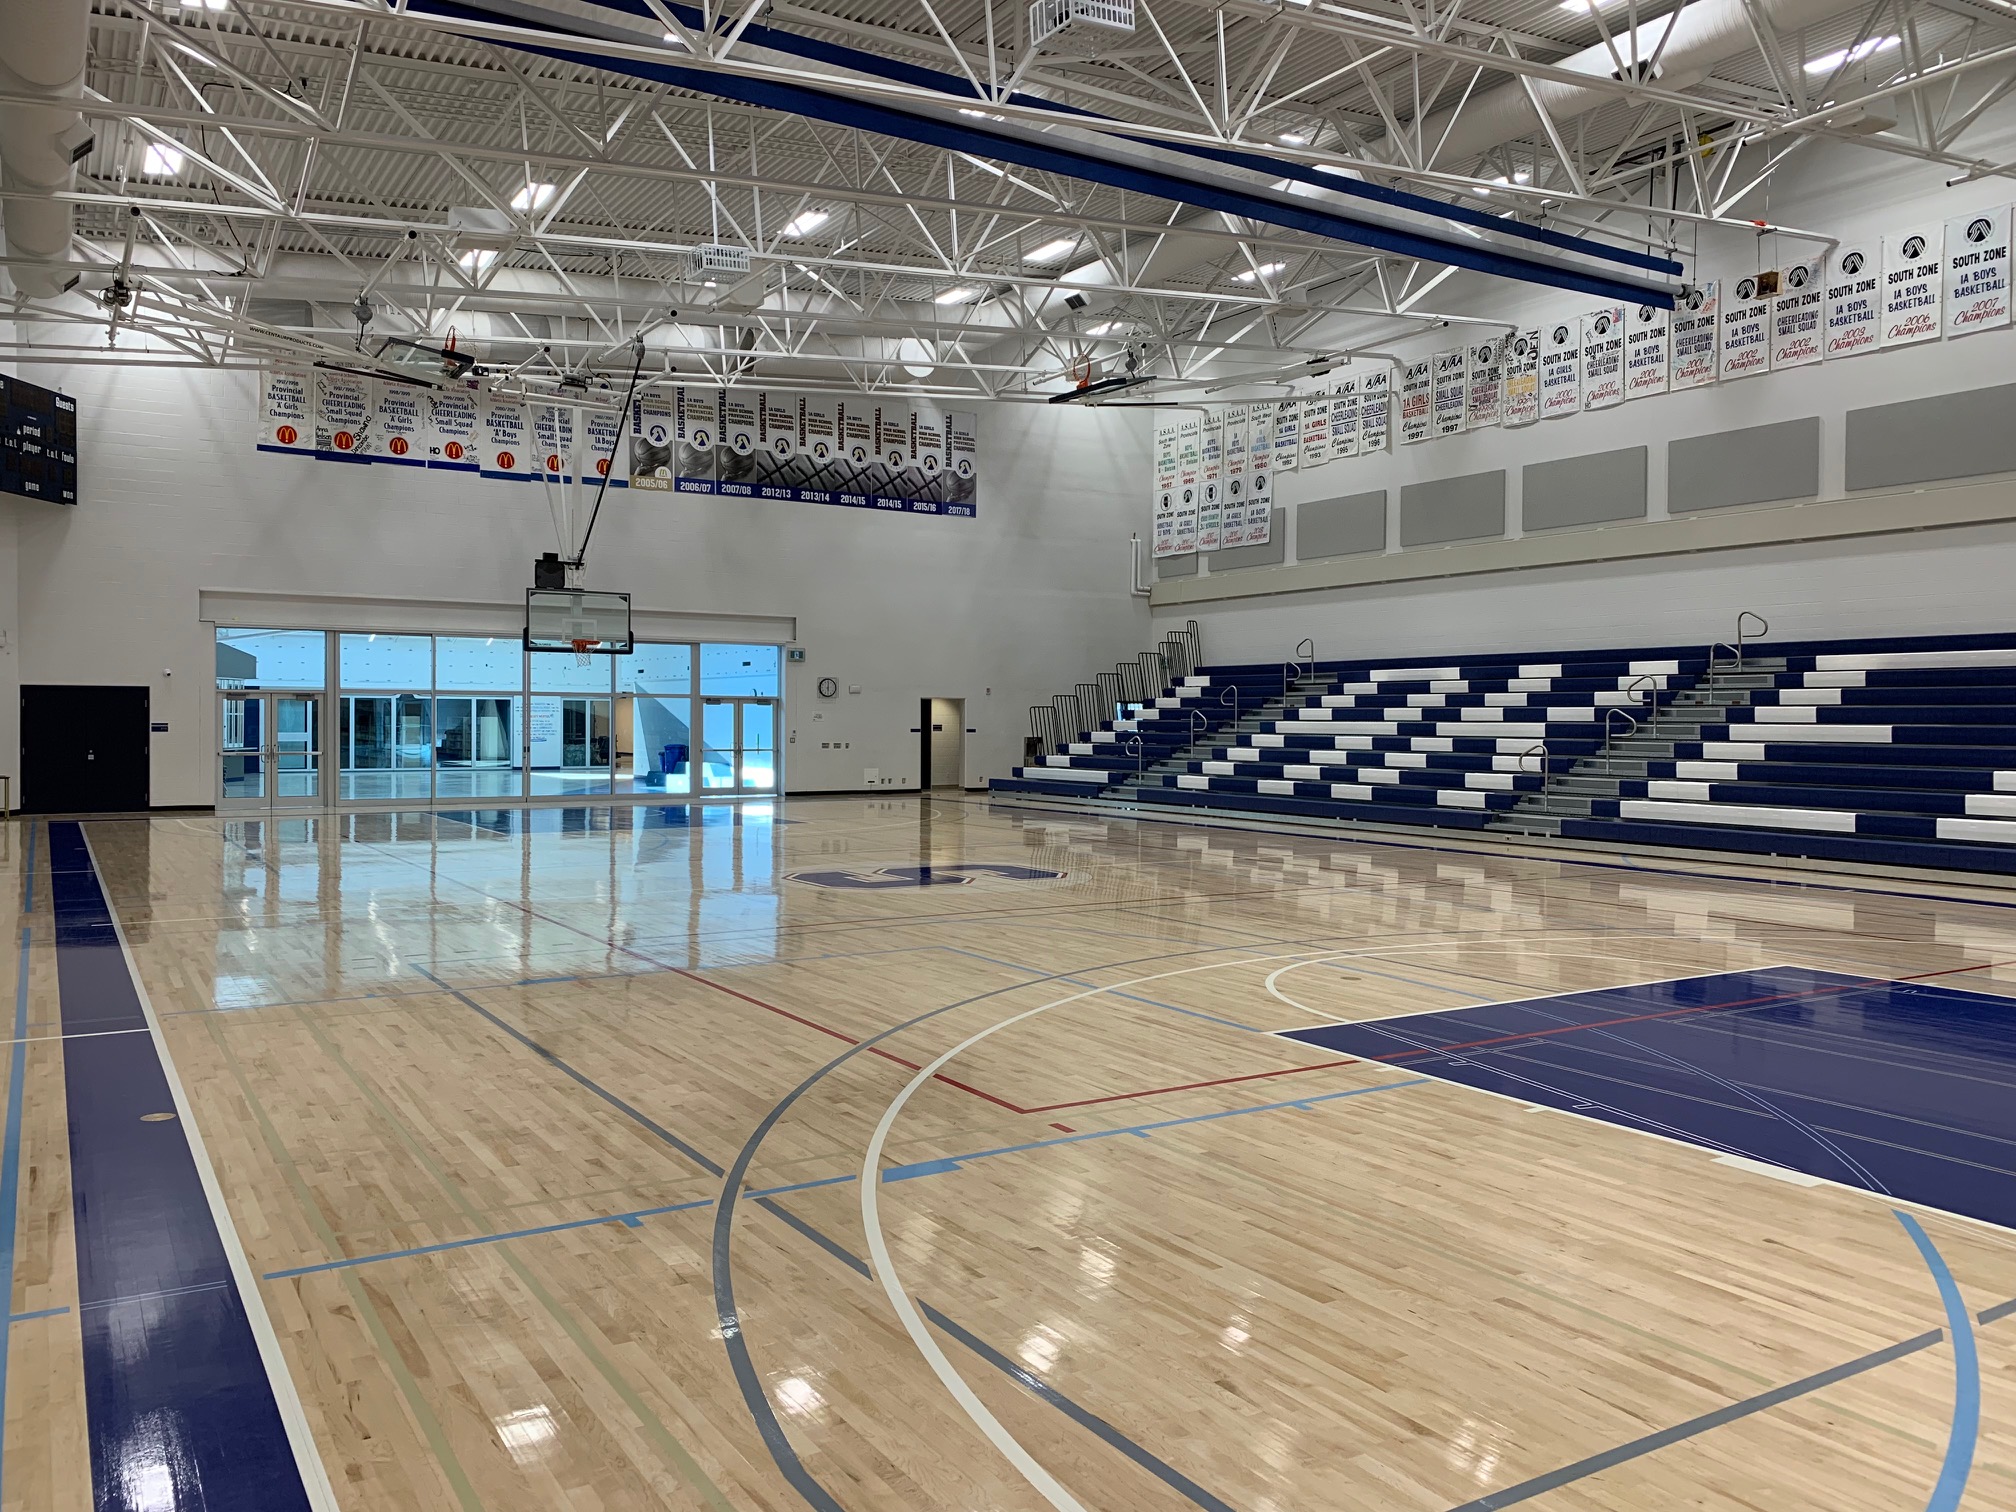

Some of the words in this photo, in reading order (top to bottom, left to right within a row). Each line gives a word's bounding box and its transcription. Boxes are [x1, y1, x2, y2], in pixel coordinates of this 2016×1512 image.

[1953, 252, 1980, 269] SOUTH
[1984, 246, 2006, 261] ZONE
[1888, 269, 1913, 284] SOUTH
[1917, 263, 1938, 276] ZONE
[1973, 267, 1996, 280] BOYS
[1829, 284, 1853, 299] SOUTH
[1856, 279, 1876, 293] ZONE
[1906, 284, 1927, 296] BOYS
[1954, 279, 2005, 298] BASKETBALL
[1777, 297, 1799, 312] SOUTH
[1802, 292, 1820, 306] ZONE
[1847, 300, 1867, 312] BOYS
[1888, 294, 1935, 312] BASKETBALL
[1971, 298, 1999, 312] 2007
[1725, 310, 1746, 324] SOUTH
[1749, 305, 1766, 317] ZONE
[1777, 310, 1818, 327] CHEERLEADING
[1830, 310, 1874, 327] BASKETBALL
[1904, 313, 1930, 326] 2006
[1954, 306, 2005, 325] Champions
[1675, 321, 1694, 333] SOUTH
[1697, 315, 1714, 328] ZONE
[1741, 323, 1759, 334] BOYS
[1778, 324, 1795, 336] SMALL
[1798, 320, 1816, 332] SQUAD
[1629, 332, 1647, 344] SOUTH
[1650, 327, 1665, 339] ZONE
[1842, 327, 1866, 340] 2003
[1888, 322, 1936, 339] Champions
[1676, 333, 1713, 348] CHEERLEADING
[1725, 332, 1765, 350] BASKETBALL
[1789, 337, 1811, 350] 2002
[1828, 335, 1874, 352] Champions
[1585, 344, 1604, 356] SOUTH
[1606, 338, 1622, 350] ZONE
[1644, 345, 1659, 356] BOYS
[1677, 346, 1692, 357] SMALL
[1694, 342, 1712, 354] SQUAD
[1543, 354, 1561, 366] SOUTH
[1563, 349, 1578, 360] ZONE
[1738, 349, 1758, 361] 2002
[1776, 346, 1818, 361] Champions
[1587, 355, 1619, 370] CHEERLEADING
[1629, 354, 1664, 368] BASKETBALL
[1687, 358, 1703, 368] 2001
[1724, 357, 1764, 372] Champions
[1556, 364, 1572, 374] GIRLS
[1588, 368, 1602, 378] SMALL
[1604, 364, 1618, 374] SQUAD
[1640, 368, 1656, 378] 2001
[1675, 365, 1712, 380] Champions
[1437, 376, 1451, 384] SOUTH
[1453, 371, 1464, 380] ZONE
[1544, 374, 1576, 387] BASKETBALL
[1629, 376, 1664, 389] Champions
[272, 385, 303, 394] Provincial
[1404, 382, 1417, 392] SOUTH
[1418, 380, 1430, 389] ZONE
[1599, 381, 1615, 392] 2000
[268, 393, 306, 403] BASKETBALL
[329, 391, 359, 401] Provincial
[1436, 389, 1449, 401] SMALL
[1450, 386, 1463, 397] SQUAD
[1555, 389, 1572, 400] 2000
[1587, 388, 1620, 402] Champions
[56, 397, 74, 412] Guests
[322, 399, 365, 410] CHEERLEADING
[384, 398, 415, 408] Provincial
[439, 401, 469, 410] Provincial
[1403, 397, 1410, 408] 1A
[1412, 393, 1430, 407] GIRLS
[1435, 401, 1463, 411] CHEERLEADING
[1544, 397, 1576, 409] Champions
[270, 409, 304, 419] Champions
[379, 406, 419, 417] BASKETBALL
[432, 409, 476, 420] CHEERLEADING
[491, 412, 520, 420] Provincial
[643, 409, 671, 417] CHAMPIONS
[1304, 410, 1316, 418] SOUTH
[1317, 406, 1327, 414] ZONE
[1403, 408, 1428, 419] BASKETBALL
[327, 415, 361, 425] Champions
[454, 420, 472, 428] Squad
[687, 414, 714, 422] CHAMPIONS
[1437, 414, 1462, 424] Champions
[384, 423, 414, 432] Champions
[486, 419, 524, 430] BASKETBALL
[591, 420, 618, 429] Provincial
[1403, 422, 1427, 432] Champions
[1442, 424, 1458, 433] 1997
[23, 425, 40, 437] period
[439, 427, 469, 435] Champions
[502, 429, 516, 439] Boys
[1408, 431, 1423, 440] 1997
[491, 437, 520, 446] Champions
[1304, 433, 1327, 443] BASKETBALL
[23, 441, 41, 454] player
[62, 452, 74, 464] fouls
[25, 482, 39, 491] game
[636, 478, 667, 488] 2005/06
[680, 482, 711, 492] 2006/07
[722, 484, 751, 494] 2007/08
[762, 488, 791, 498] 2012/13
[801, 491, 829, 501] 2013/14
[841, 495, 865, 505] 2014/15
[878, 499, 901, 508] 2014/15
[914, 502, 936, 511] 2015/16
[948, 506, 970, 515] 2017/18
